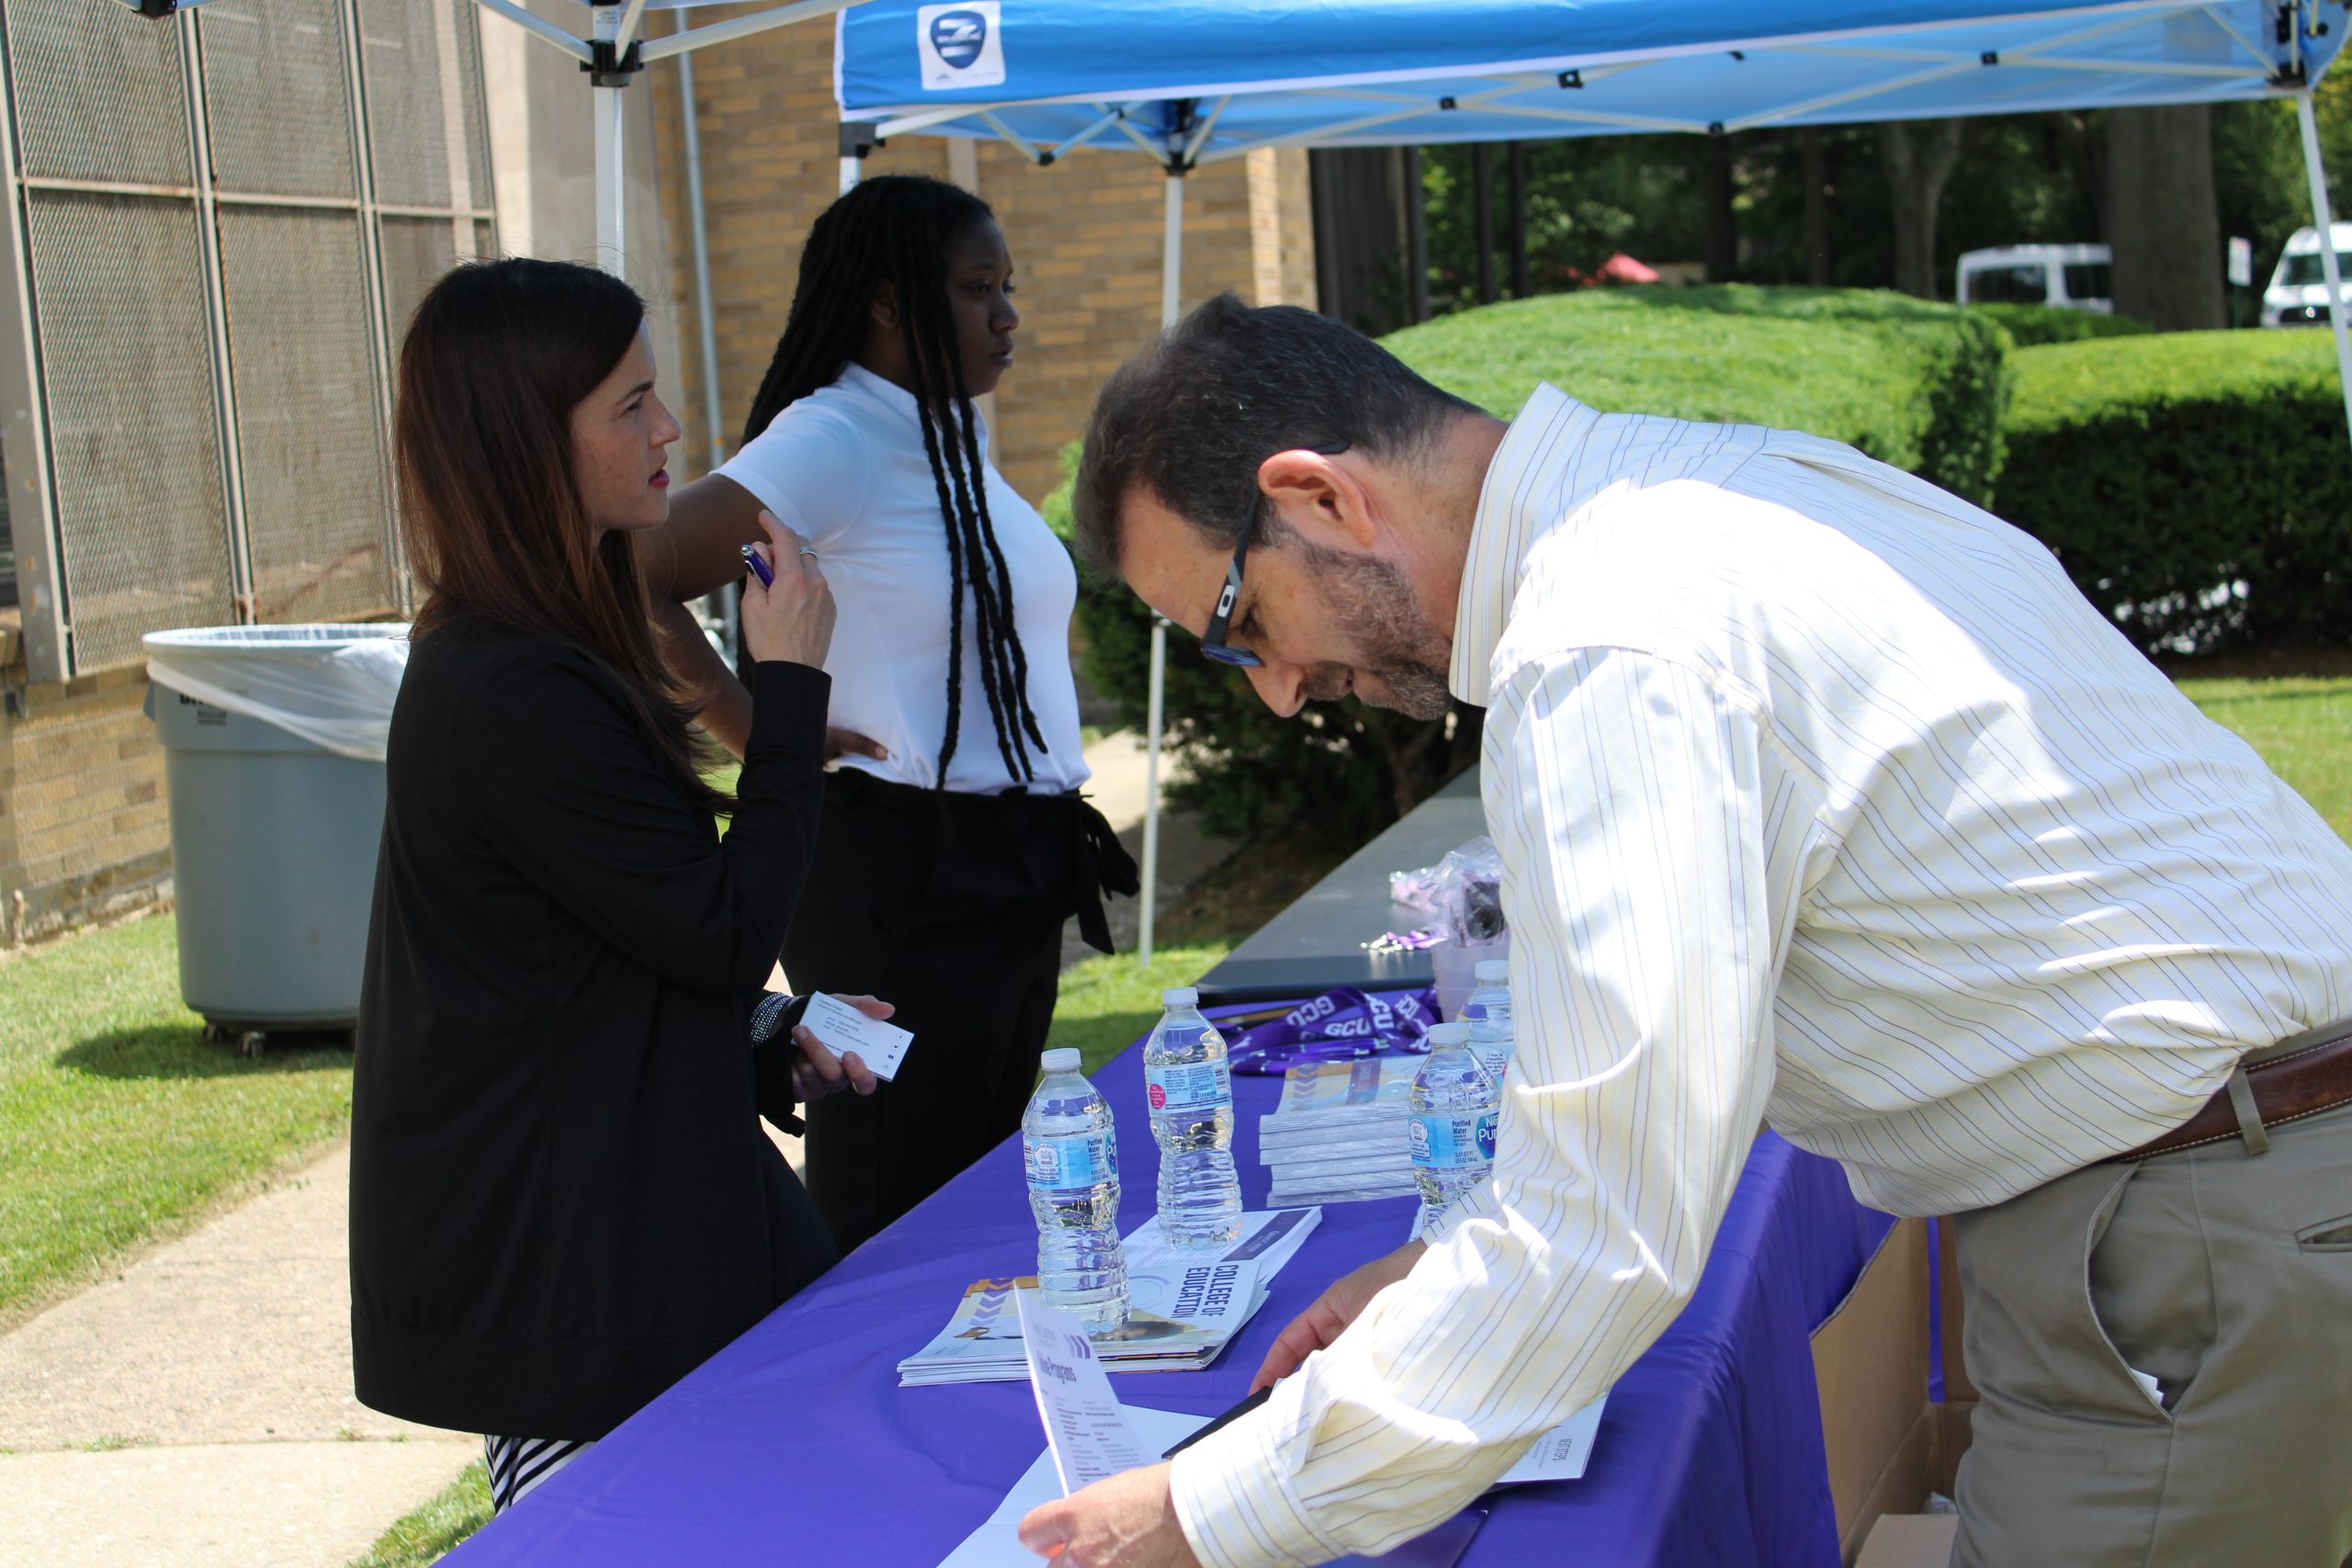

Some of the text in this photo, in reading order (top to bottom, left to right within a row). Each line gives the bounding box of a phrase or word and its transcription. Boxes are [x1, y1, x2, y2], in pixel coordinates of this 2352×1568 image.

[1286, 995, 1336, 1027] GCU
[1324, 1017, 1372, 1036] GCU
[1452, 1120, 1471, 1128] Purified
[1170, 1267, 1211, 1319] EDUCATION
[1200, 1264, 1239, 1316] COLLEGE OF
